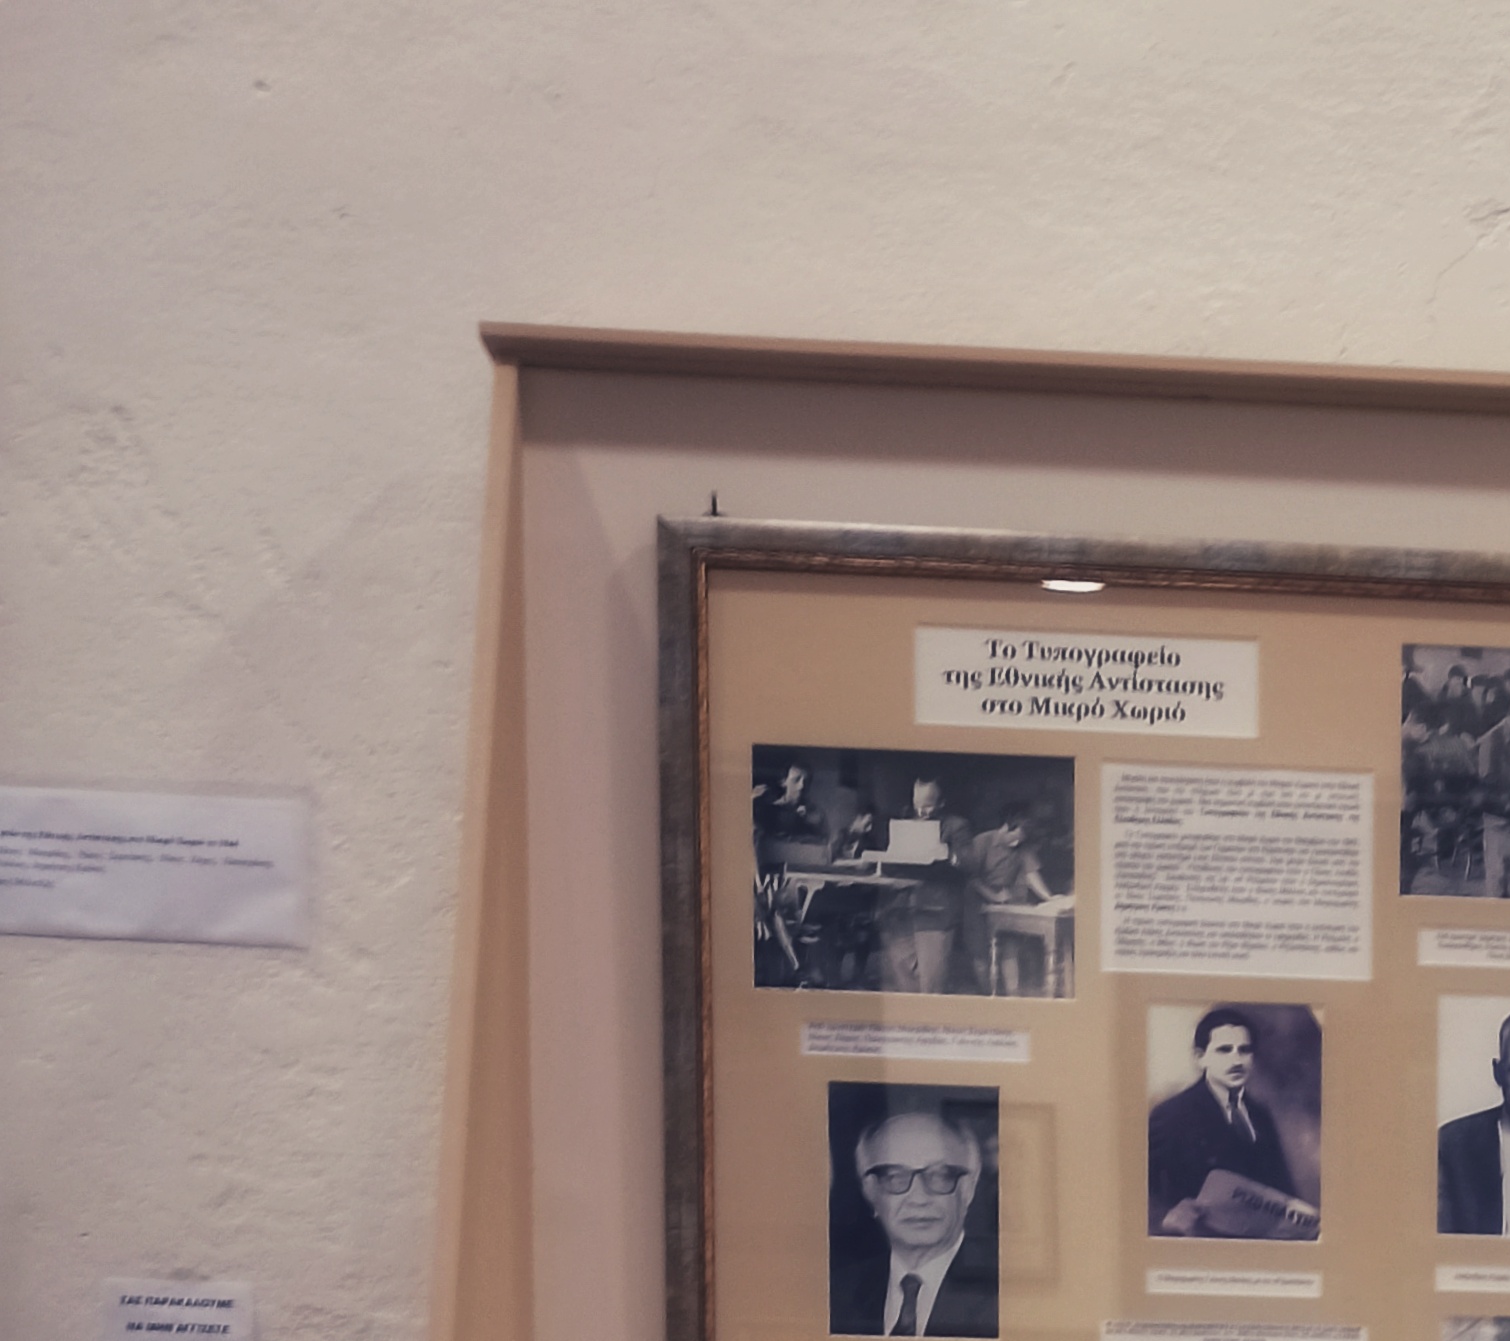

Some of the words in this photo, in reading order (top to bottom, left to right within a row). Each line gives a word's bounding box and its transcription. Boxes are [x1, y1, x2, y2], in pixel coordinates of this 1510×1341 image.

[985, 638, 1017, 661] Το
[1023, 640, 1182, 668] Τυπογραφείο
[943, 669, 982, 690] της
[989, 666, 1083, 694] Εθνικής
[1089, 668, 1224, 700] Αντίστασης
[981, 698, 1022, 715] στο
[1029, 695, 1106, 722] Μικρό
[1112, 699, 1187, 724] Χωριό
